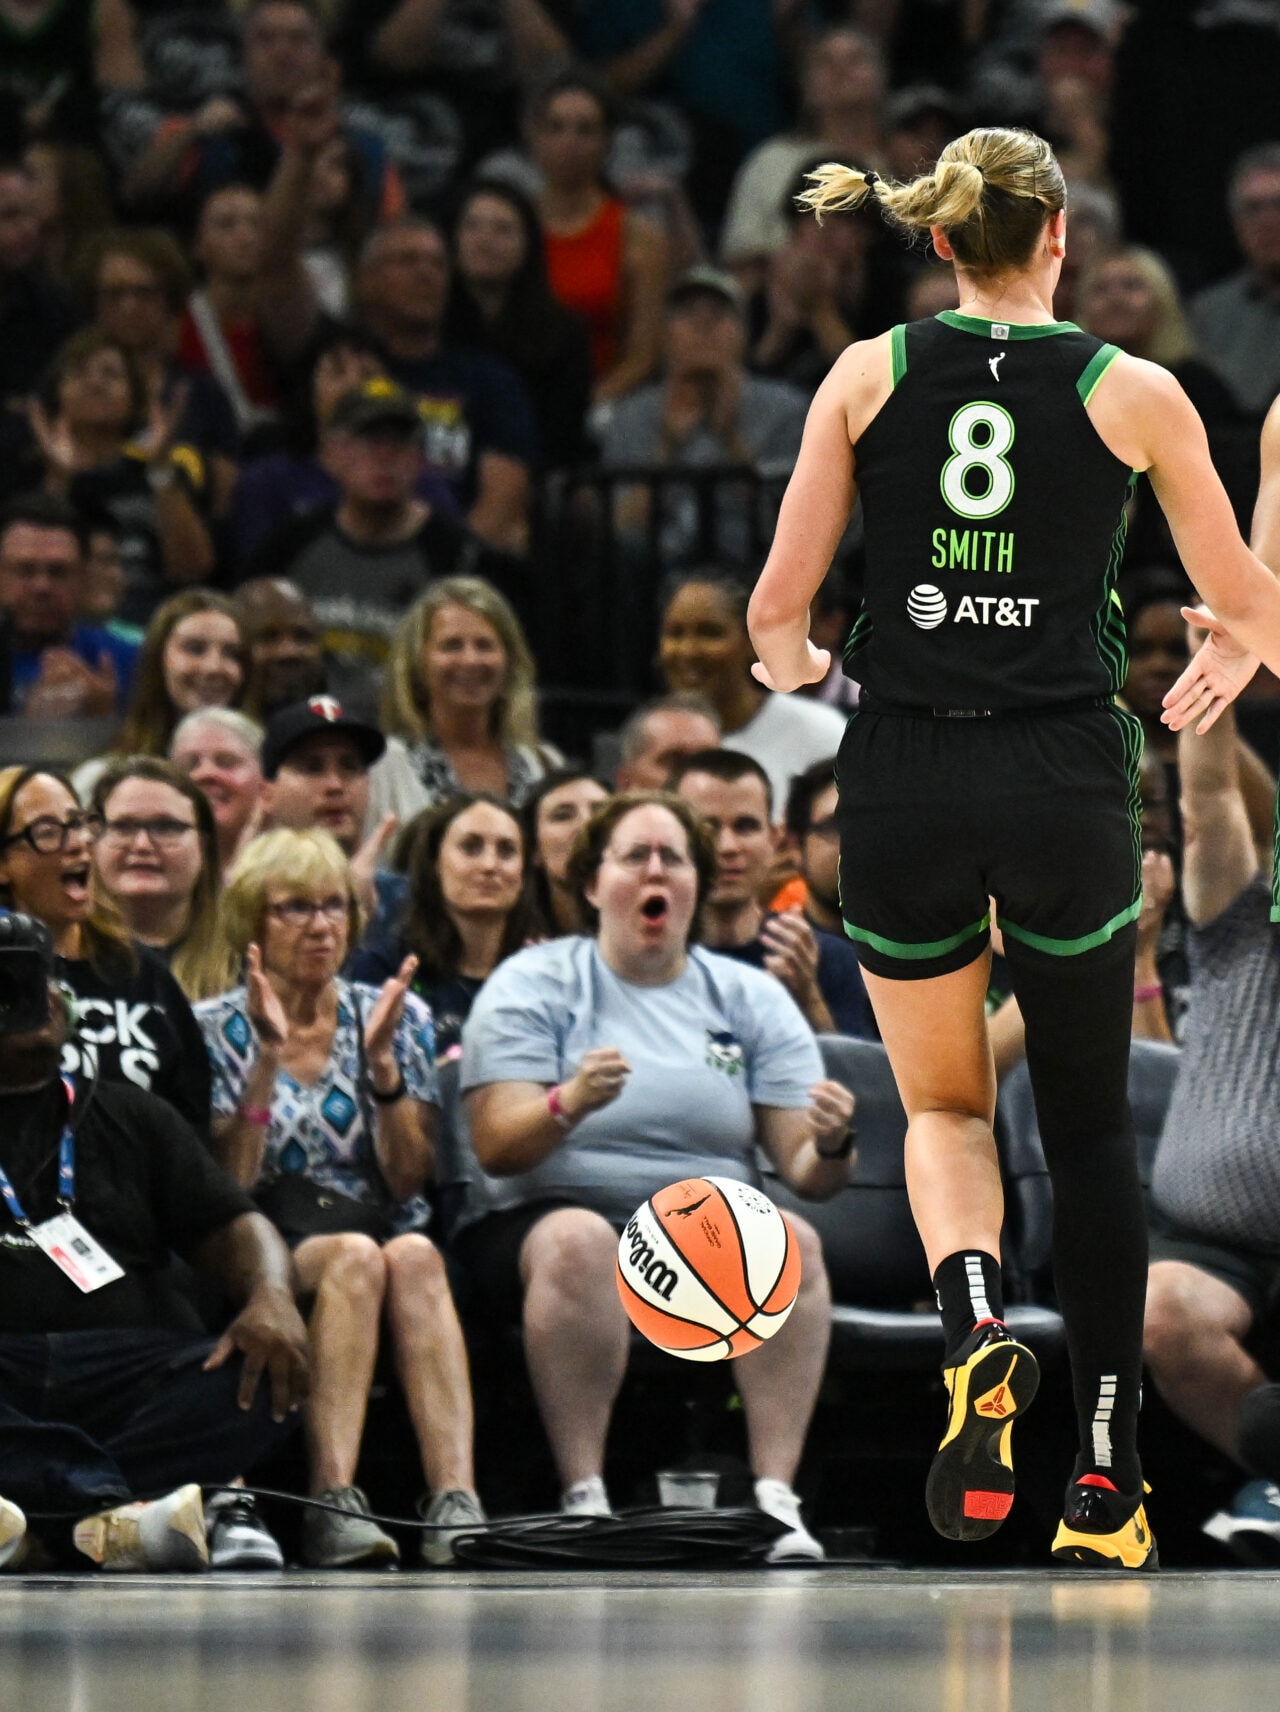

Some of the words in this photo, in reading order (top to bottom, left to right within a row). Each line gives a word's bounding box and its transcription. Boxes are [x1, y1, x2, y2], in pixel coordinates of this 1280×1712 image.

[940, 401, 1015, 520] 8
[931, 528, 1014, 573] SMITH
[953, 595, 1040, 627] AT&T
